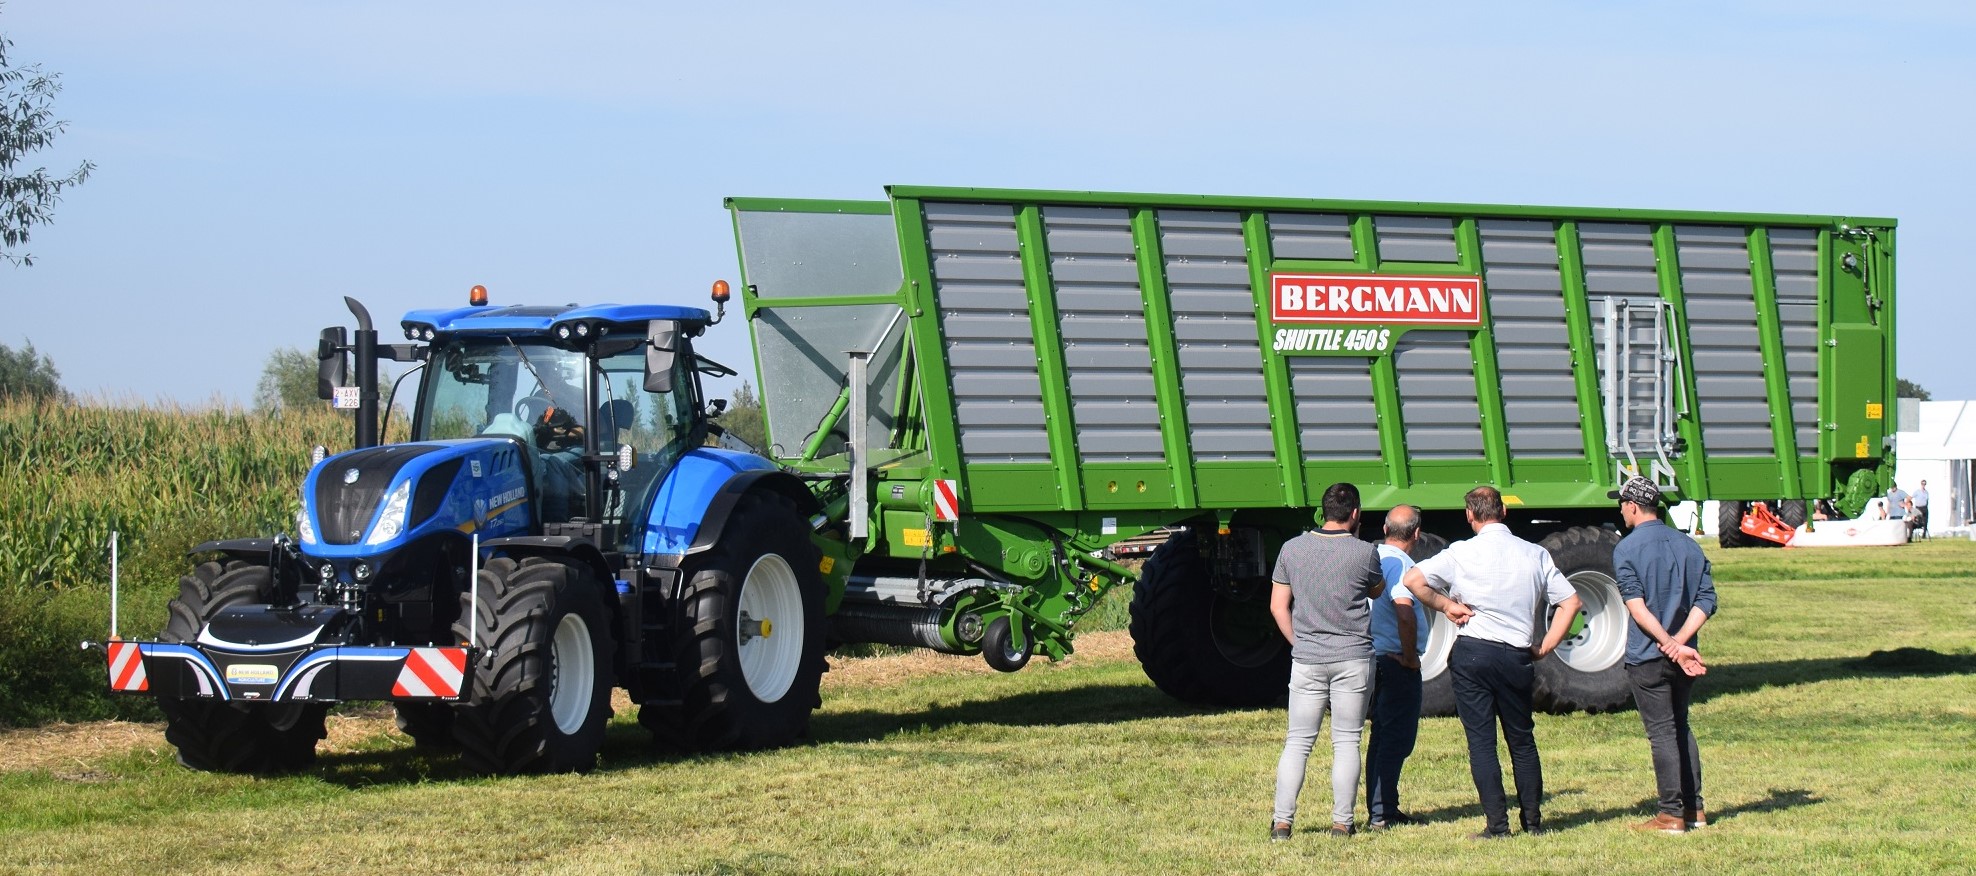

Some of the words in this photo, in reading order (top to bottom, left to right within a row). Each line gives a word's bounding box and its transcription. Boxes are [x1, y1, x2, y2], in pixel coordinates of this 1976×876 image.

[1281, 285, 1472, 313] BERGMANN
[1273, 328, 1344, 351] SHUTTLE
[344, 398, 359, 407] 226
[489, 494, 503, 510] NEW
[502, 486, 525, 504] HOLLAND
